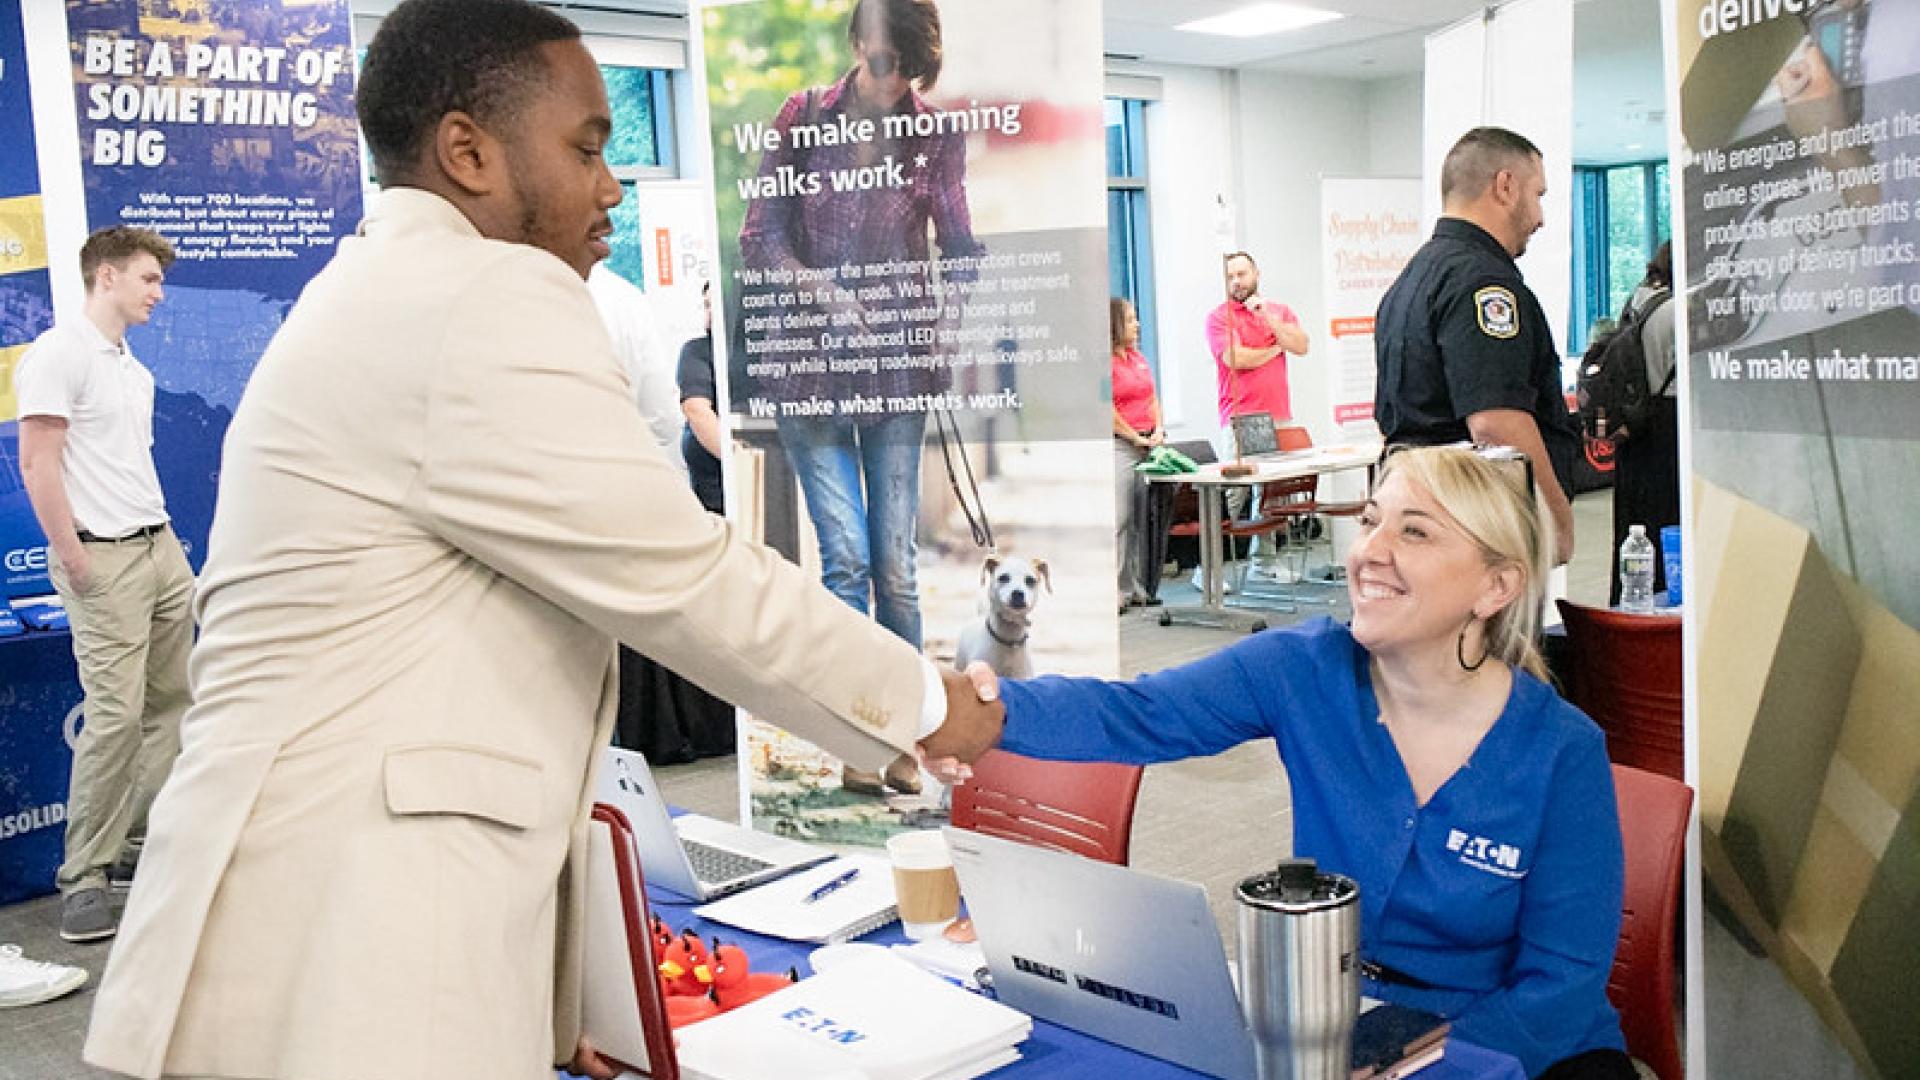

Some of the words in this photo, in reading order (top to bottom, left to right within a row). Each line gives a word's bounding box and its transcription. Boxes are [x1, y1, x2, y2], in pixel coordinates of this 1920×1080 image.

[1699, 0, 1816, 38] delive
[84, 36, 134, 75] BE
[146, 42, 173, 78] A
[186, 46, 286, 83] PART
[297, 51, 343, 86] OF
[88, 84, 318, 127] SOMETHING
[734, 123, 781, 154] We
[790, 114, 875, 148] make
[882, 101, 1021, 139] morning
[1729, 136, 1796, 170] energize
[1799, 127, 1828, 156] and
[1831, 118, 1887, 153] protect
[1893, 110, 1920, 137] the
[94, 129, 166, 167] BIG
[738, 166, 821, 200] walks
[1703, 184, 1747, 211] online
[1838, 164, 1888, 192] power
[1893, 152, 1920, 181] the
[1705, 216, 1767, 250] products
[763, 267, 794, 284] help
[798, 268, 838, 282] power
[841, 260, 861, 278] the
[865, 260, 930, 279] machinery
[936, 256, 1015, 270] construction
[1018, 251, 1062, 266] crews
[743, 293, 776, 310] count
[778, 291, 796, 306] on
[799, 288, 813, 305] to
[816, 286, 832, 302] fix
[835, 286, 856, 302] the
[857, 282, 894, 301] roads.
[898, 279, 921, 298] We
[1002, 275, 1070, 291] treatment
[1868, 279, 1904, 309] part
[744, 315, 781, 333] plants
[783, 313, 830, 329] deliver
[864, 309, 898, 322] clean
[901, 307, 943, 322] water
[946, 302, 960, 320] to
[962, 303, 1012, 318] homes
[1014, 299, 1036, 314] and
[747, 337, 817, 353] businesses.
[821, 332, 844, 350] Our
[848, 331, 905, 346] advanced
[908, 327, 933, 345] LED
[1017, 323, 1050, 339] save
[747, 363, 787, 378] energy
[791, 356, 827, 372] while
[831, 354, 878, 374] keeping
[881, 350, 945, 371] roadways
[948, 351, 973, 365] and
[1708, 351, 1742, 381] We
[1747, 349, 1811, 379] make
[1816, 349, 1870, 379] what
[749, 397, 777, 418] We
[781, 395, 835, 414] make
[840, 392, 883, 414] what
[885, 393, 963, 412] matters
[967, 388, 1024, 411] work.
